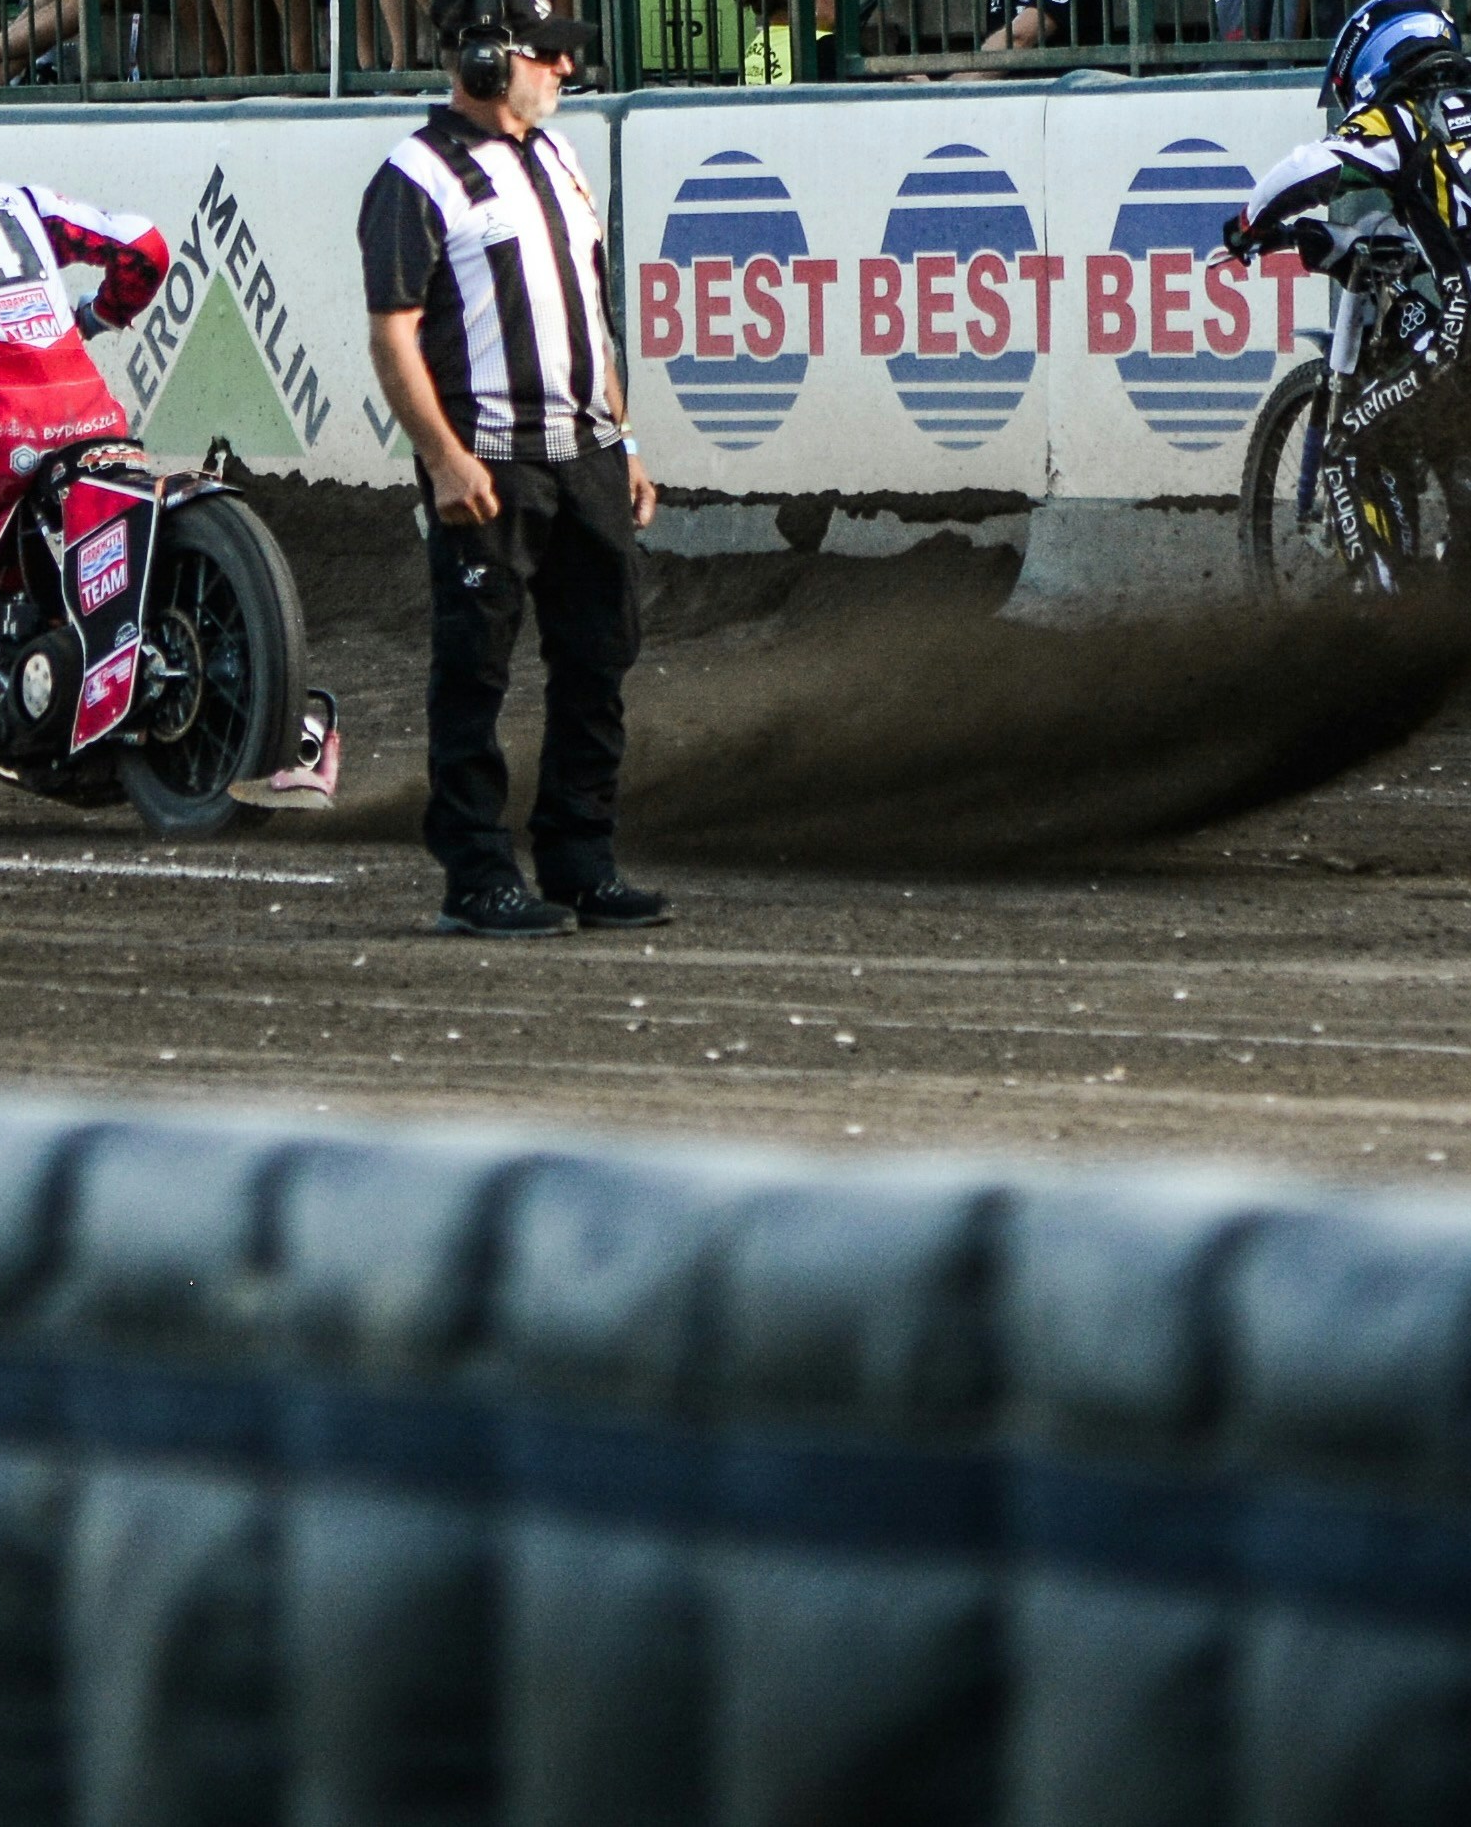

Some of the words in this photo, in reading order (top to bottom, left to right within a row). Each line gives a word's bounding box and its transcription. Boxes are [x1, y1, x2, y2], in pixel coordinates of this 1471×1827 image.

[4, 319, 62, 342] TEAM
[198, 164, 332, 447] MERLIN
[640, 256, 838, 360] BEST
[861, 253, 1064, 358] BEST
[1085, 249, 1312, 356] BEST
[1342, 370, 1422, 434] Stelmet
[81, 564, 127, 611] TEAM
